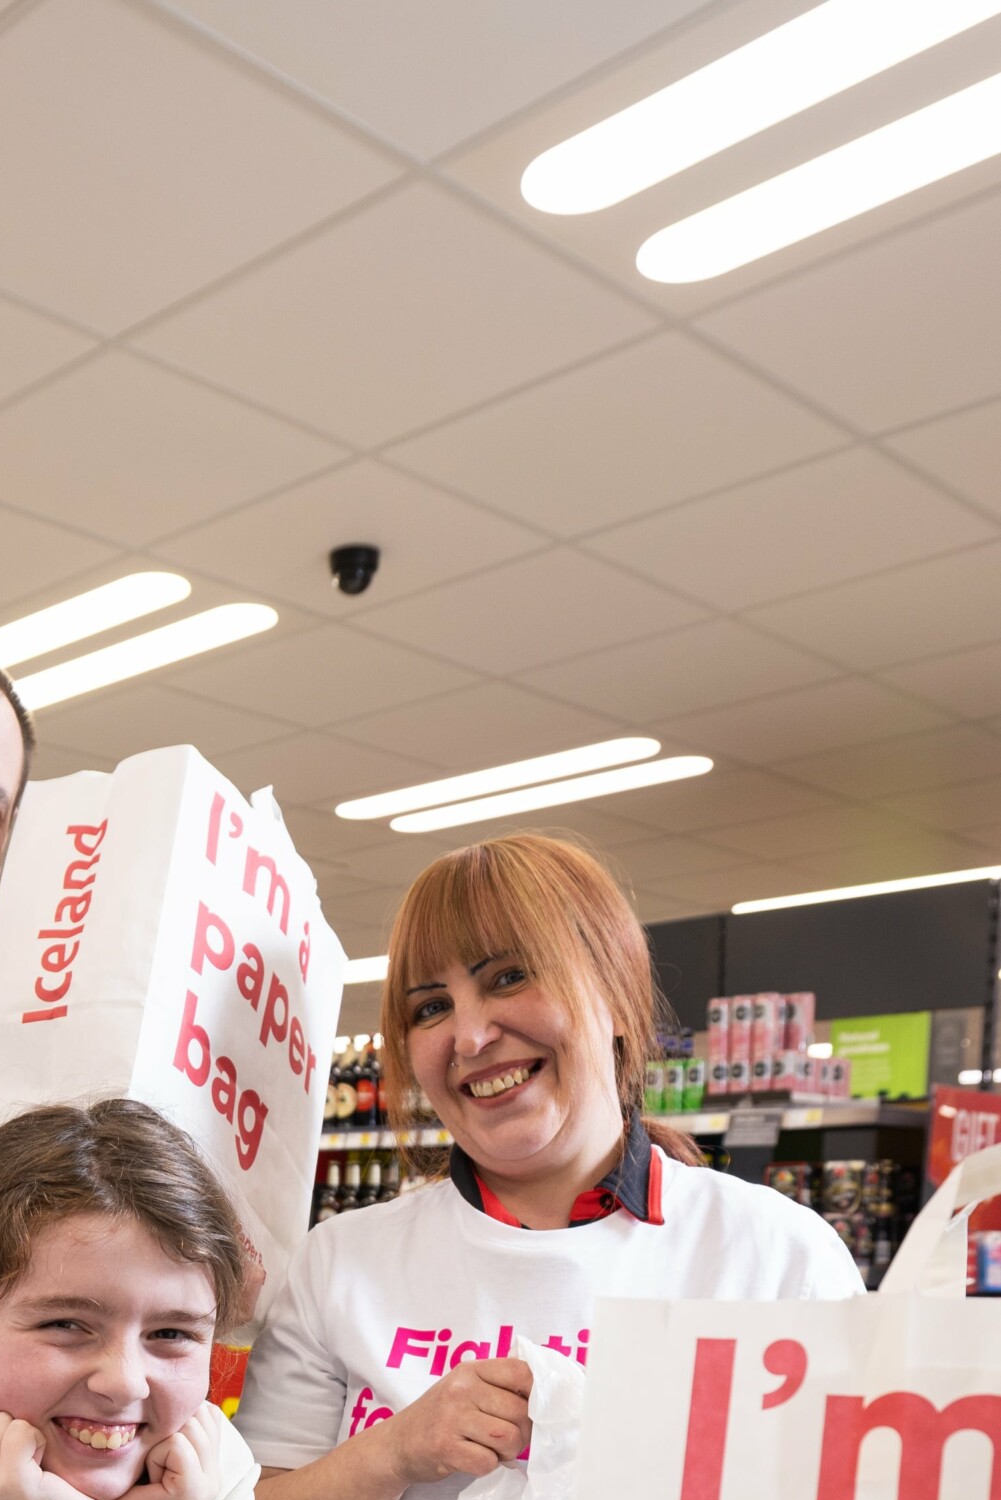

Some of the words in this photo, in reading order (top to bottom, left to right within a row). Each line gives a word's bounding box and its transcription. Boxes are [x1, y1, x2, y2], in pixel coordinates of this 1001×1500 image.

[21, 817, 109, 1024] Iceland
[204, 792, 291, 935] I'm
[172, 989, 269, 1171] bag
[189, 899, 317, 1094] paper
